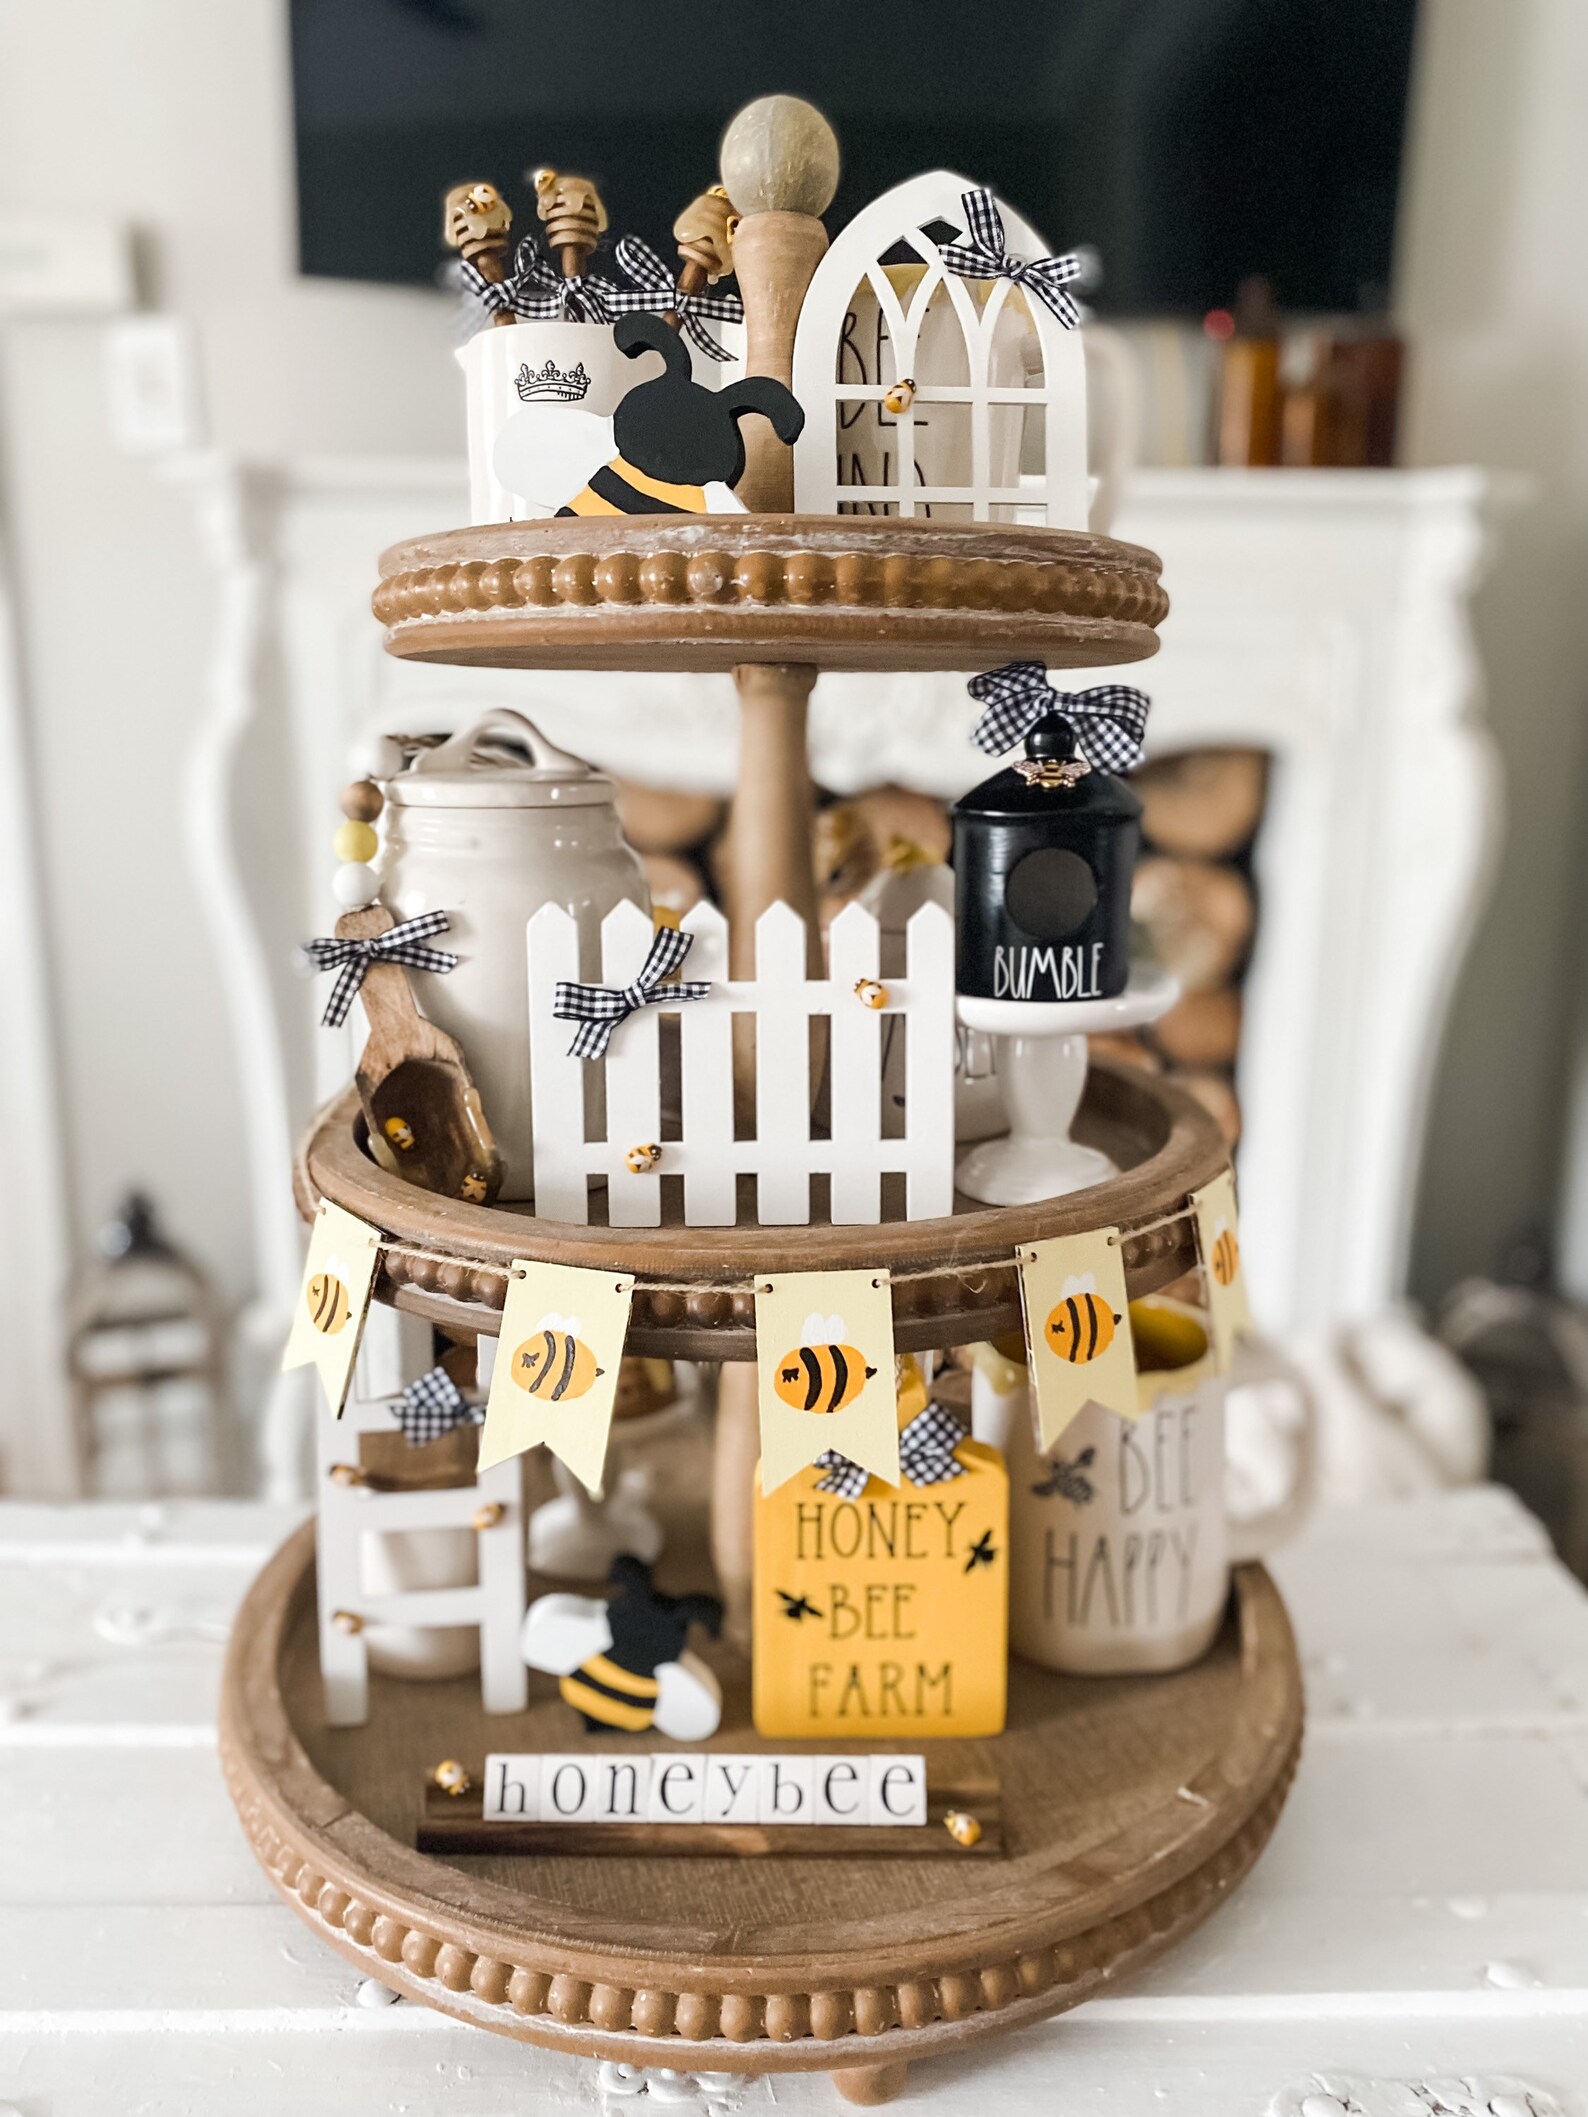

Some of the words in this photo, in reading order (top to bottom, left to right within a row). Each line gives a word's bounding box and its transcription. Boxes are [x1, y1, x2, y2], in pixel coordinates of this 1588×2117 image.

[993, 942, 1104, 1000] BUMBLE
[1118, 1404, 1197, 1516] BEE
[796, 1501, 967, 1560] HONEY
[1043, 1523, 1200, 1630] HAPPY
[829, 1583, 917, 1641] BEE
[809, 1661, 954, 1719] FARM
[494, 1759, 917, 1818] honeybee
